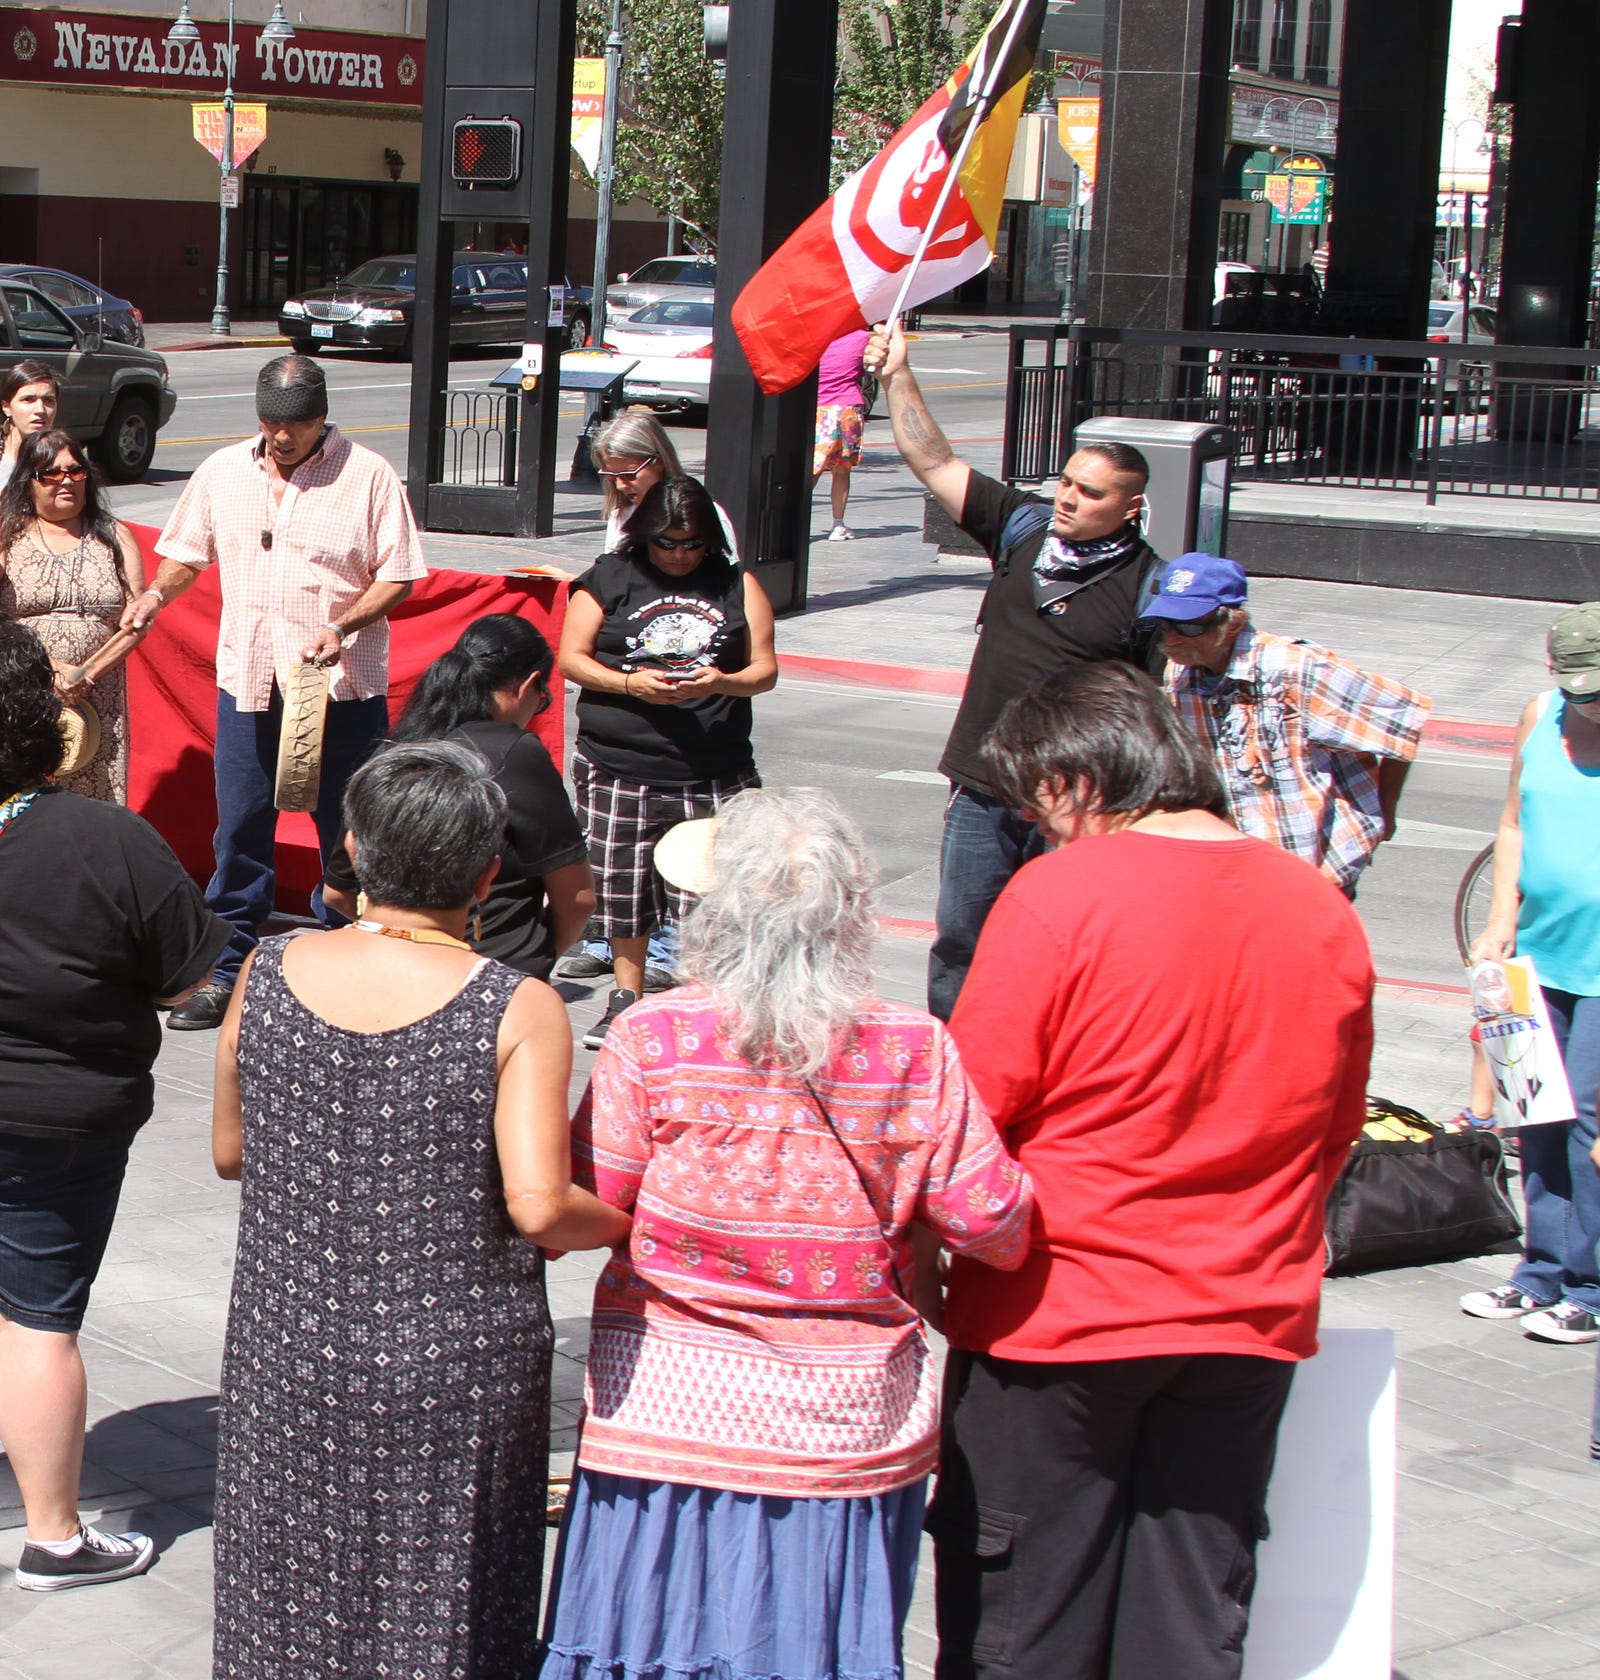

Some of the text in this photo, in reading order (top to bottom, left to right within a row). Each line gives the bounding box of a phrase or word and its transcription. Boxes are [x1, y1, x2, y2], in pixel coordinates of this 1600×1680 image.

[53, 21, 384, 89] NEVADAN TOWER
[196, 110, 258, 124] TILNG
[1480, 1018, 1542, 1040] ELTIER
